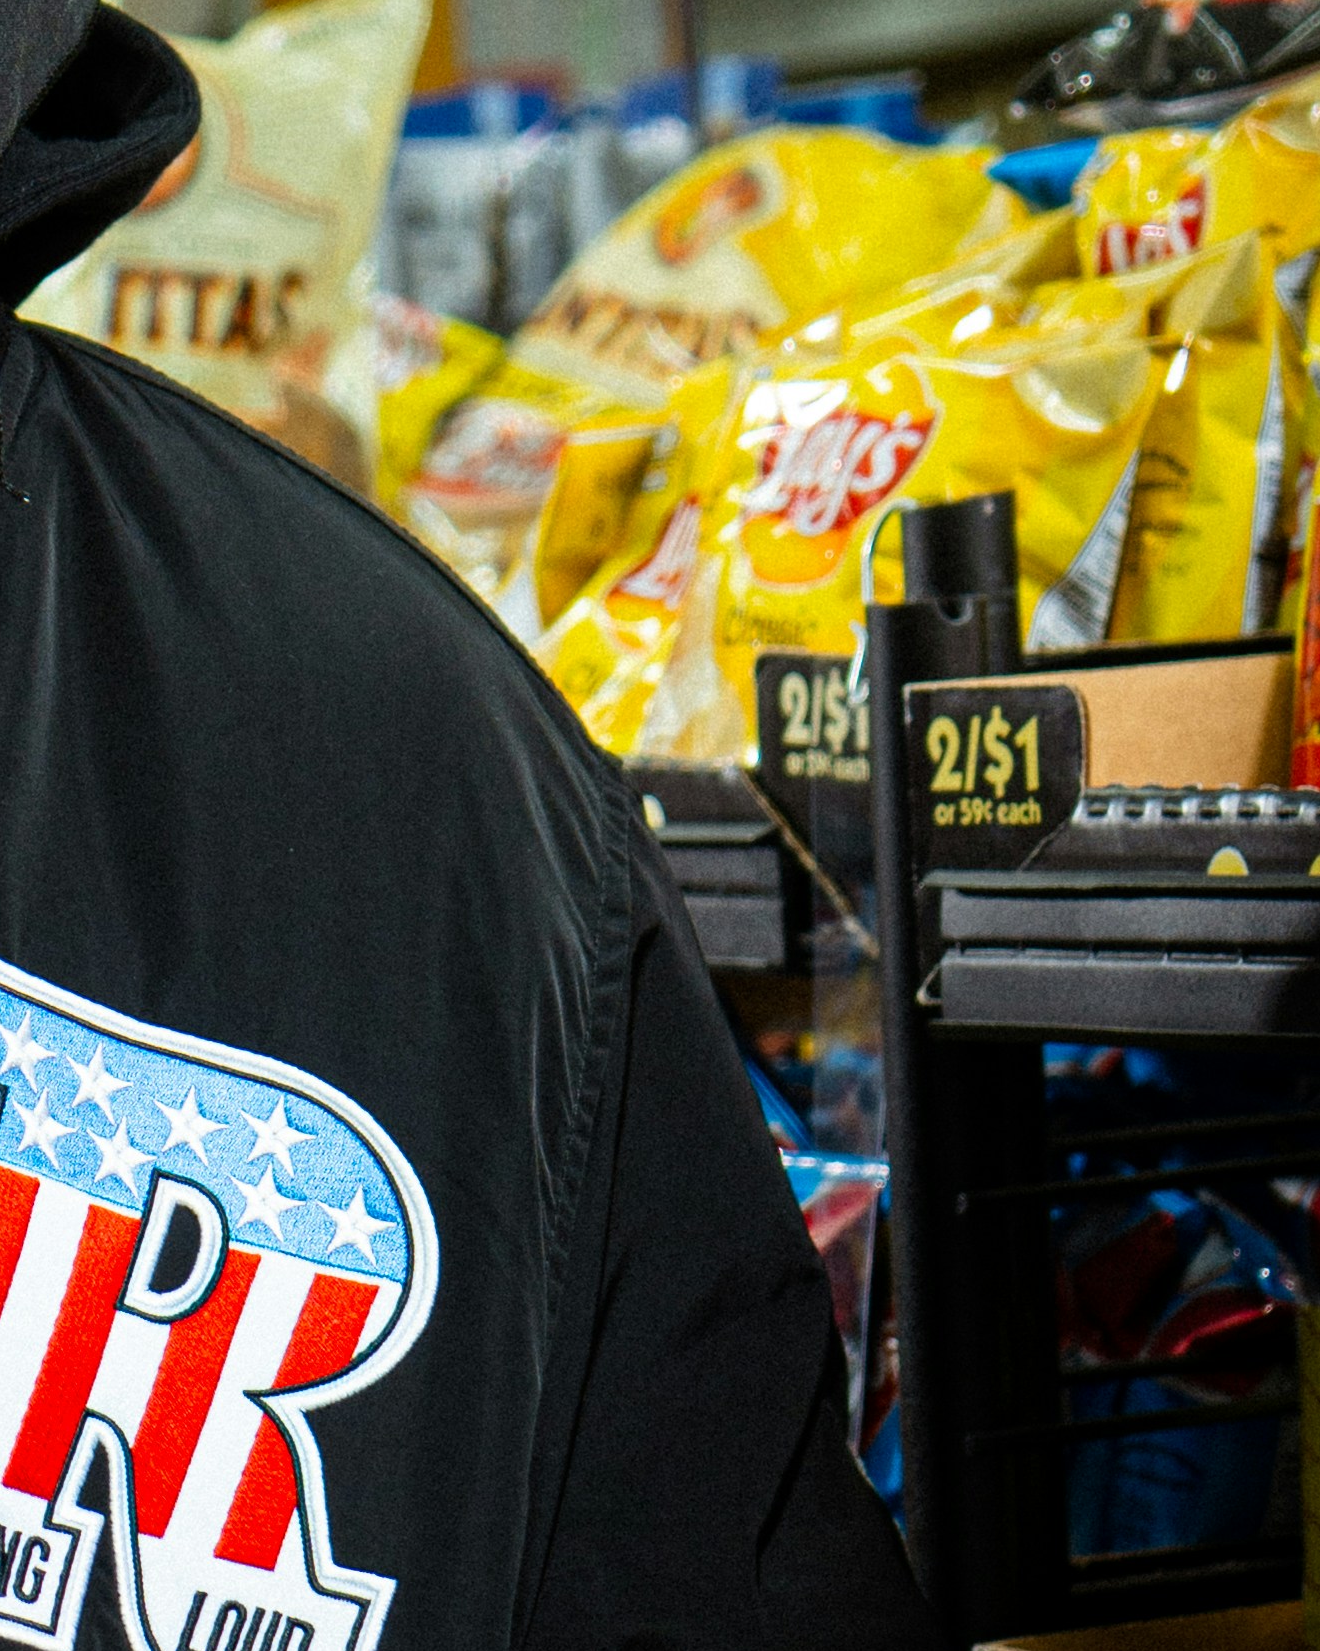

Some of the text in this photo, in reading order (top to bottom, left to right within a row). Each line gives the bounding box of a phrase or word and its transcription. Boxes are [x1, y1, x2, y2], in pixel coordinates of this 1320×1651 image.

[926, 705, 1041, 798] 2/$1
[934, 796, 1042, 826] or 59¢ each
